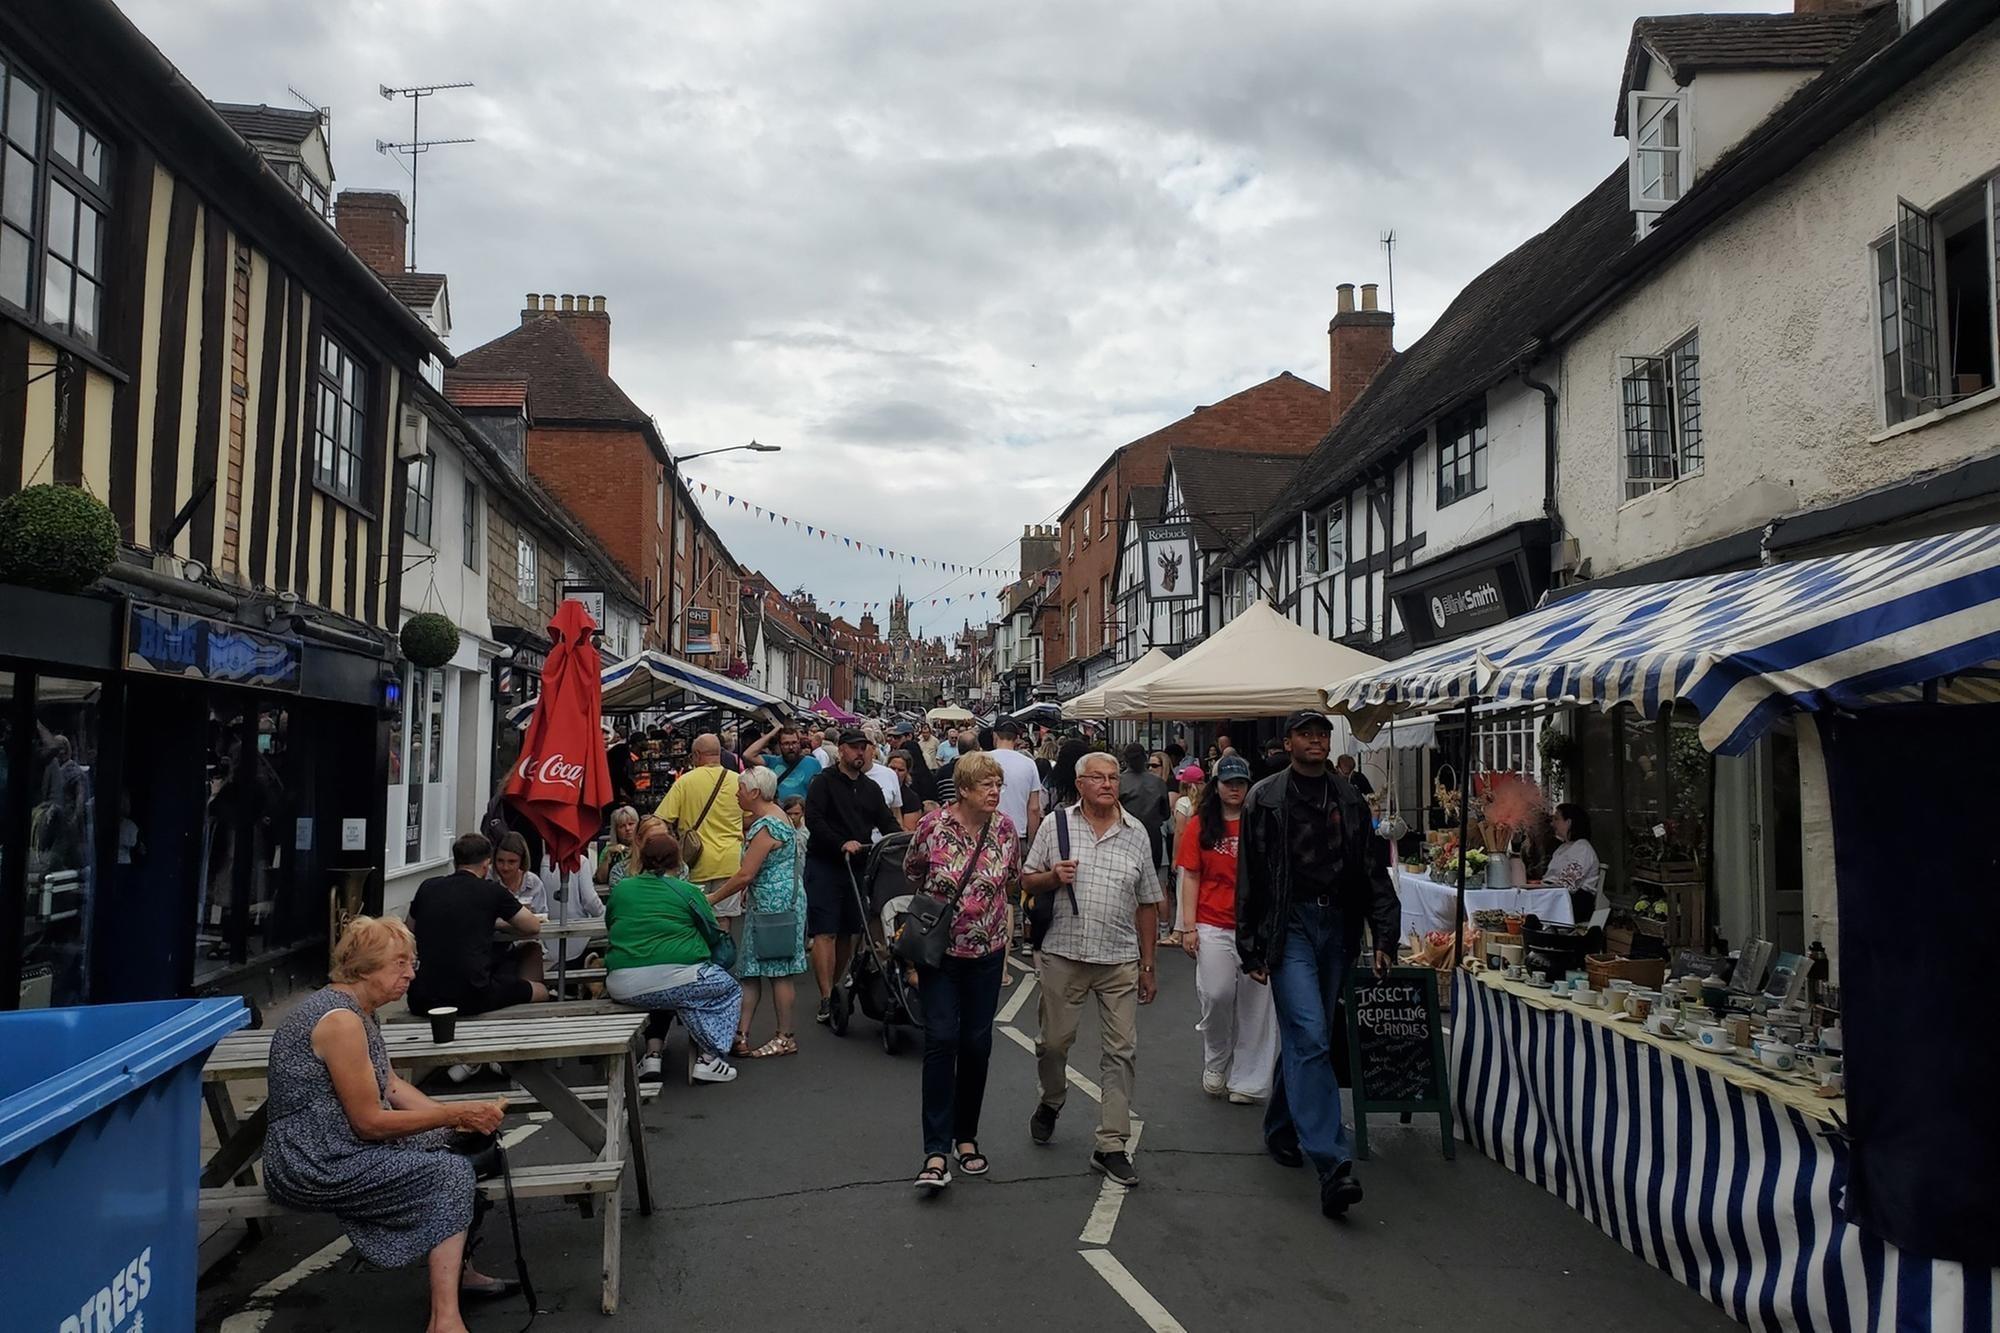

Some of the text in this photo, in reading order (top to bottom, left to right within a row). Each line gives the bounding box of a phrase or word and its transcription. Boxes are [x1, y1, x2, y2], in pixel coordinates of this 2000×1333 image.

[1148, 528, 1187, 541] Roebuck
[1355, 986, 1413, 1007] INSECT
[1357, 1005, 1427, 1028] REPELLING
[1374, 1022, 1429, 1039] CANDLES
